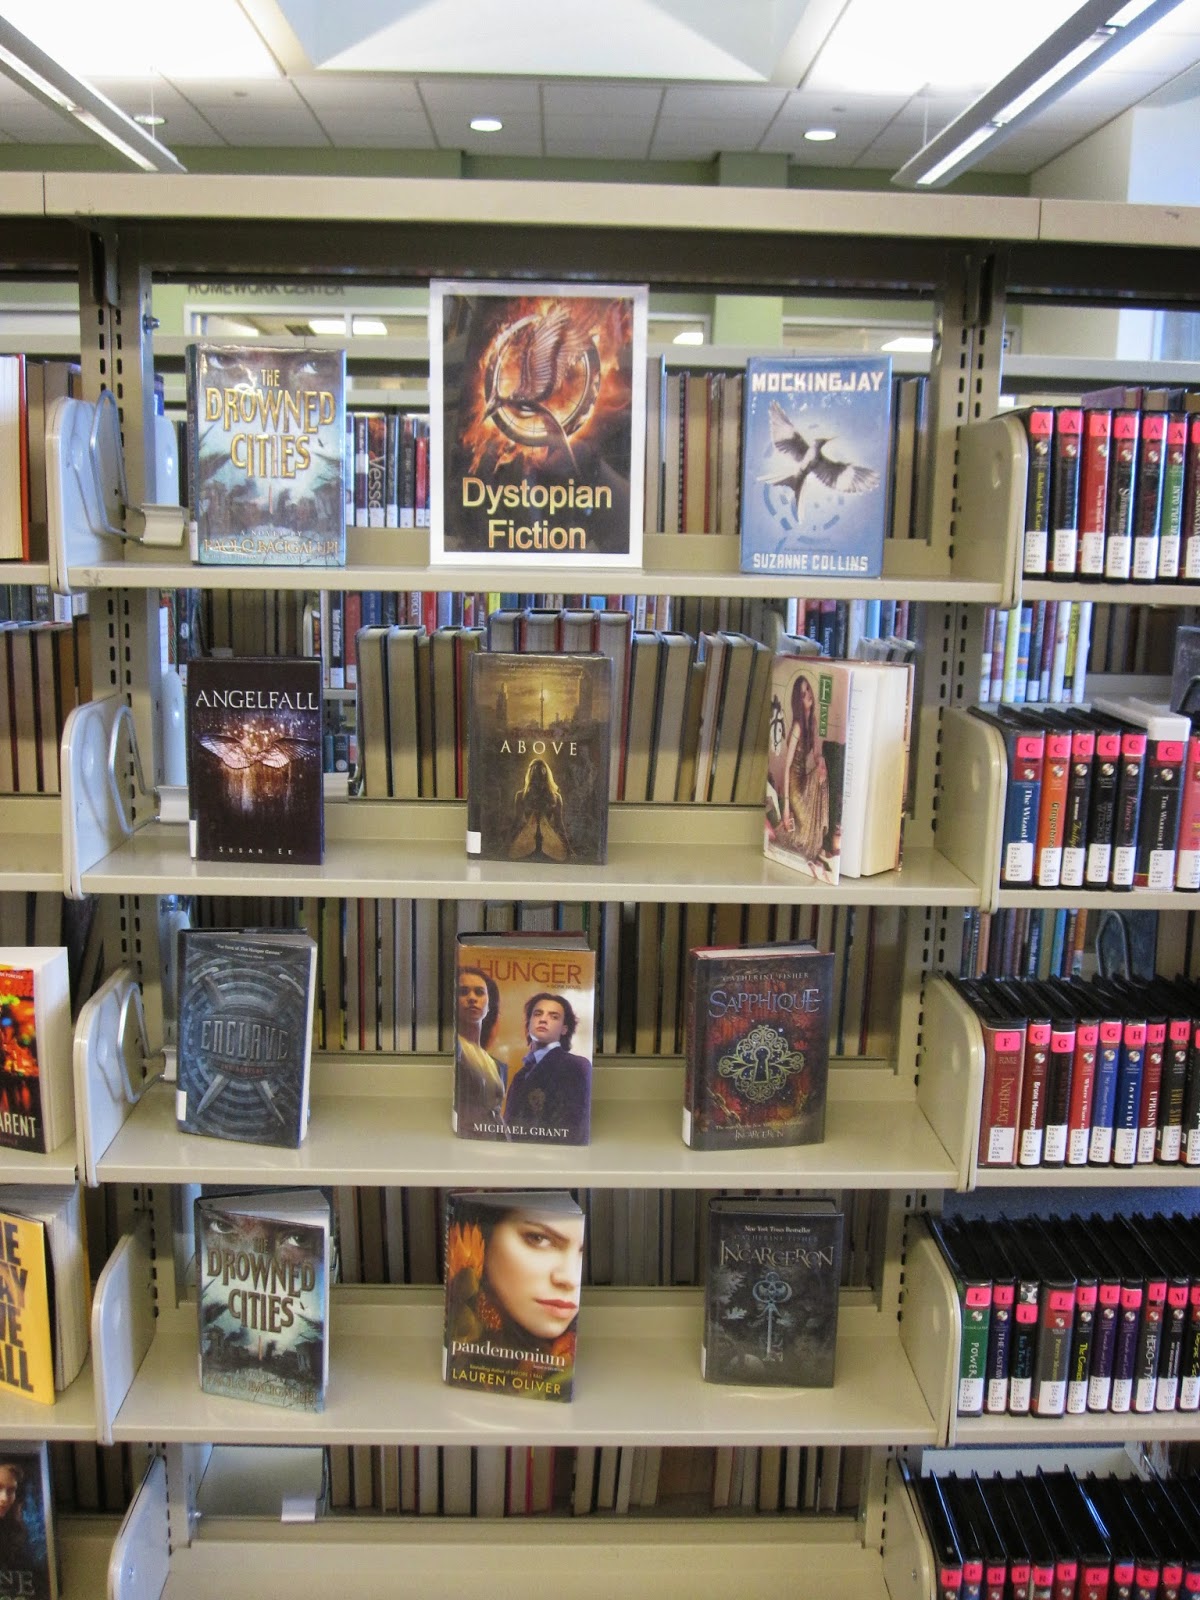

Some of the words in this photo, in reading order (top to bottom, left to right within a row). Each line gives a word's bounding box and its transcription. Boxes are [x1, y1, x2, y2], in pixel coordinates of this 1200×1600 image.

[261, 369, 280, 386] THE
[751, 371, 884, 394] MOCKINGJAY
[205, 388, 335, 434] DROWNED
[230, 434, 310, 478] CITIES
[462, 476, 613, 516] Dystopian
[488, 519, 586, 549] Fiction
[753, 553, 808, 570] SUZANNE
[811, 554, 868, 572] COLLINS
[195, 690, 319, 710] ANGELFALL
[500, 740, 578, 756] ABOVE
[1025, 742, 1036, 753] C
[1054, 743, 1064, 754] C
[1080, 740, 1088, 750] C
[1106, 740, 1114, 750] C
[1128, 740, 1138, 750] C
[1166, 746, 1176, 757] C
[1024, 790, 1032, 804] The
[1021, 807, 1031, 838] Wizard
[219, 846, 263, 854] SUSAN
[476, 958, 582, 984] HUNGER
[778, 972, 809, 980] FISHER
[708, 988, 821, 1018] SAPPHIQUE
[201, 1020, 288, 1060] ENCLAVE
[1034, 1030, 1044, 1040] G
[1084, 1032, 1094, 1042] G
[1106, 1028, 1116, 1038] G
[1132, 1030, 1142, 1040] H
[1156, 1029, 1164, 1040] H
[1178, 1027, 1186, 1037] H
[1003, 1038, 1011, 1047] F
[1058, 1038, 1068, 1049] G
[473, 1123, 527, 1136] MICHAEL
[530, 1126, 570, 1138] GRANT
[0, 1220, 21, 1266] E
[720, 1240, 834, 1268] INCARCERON
[207, 1249, 316, 1298] DROWNED
[228, 1288, 294, 1334] CITIES
[452, 1340, 565, 1366] pandemonium
[452, 1368, 506, 1386] LAUREN
[512, 1378, 560, 1394] OLIVER
